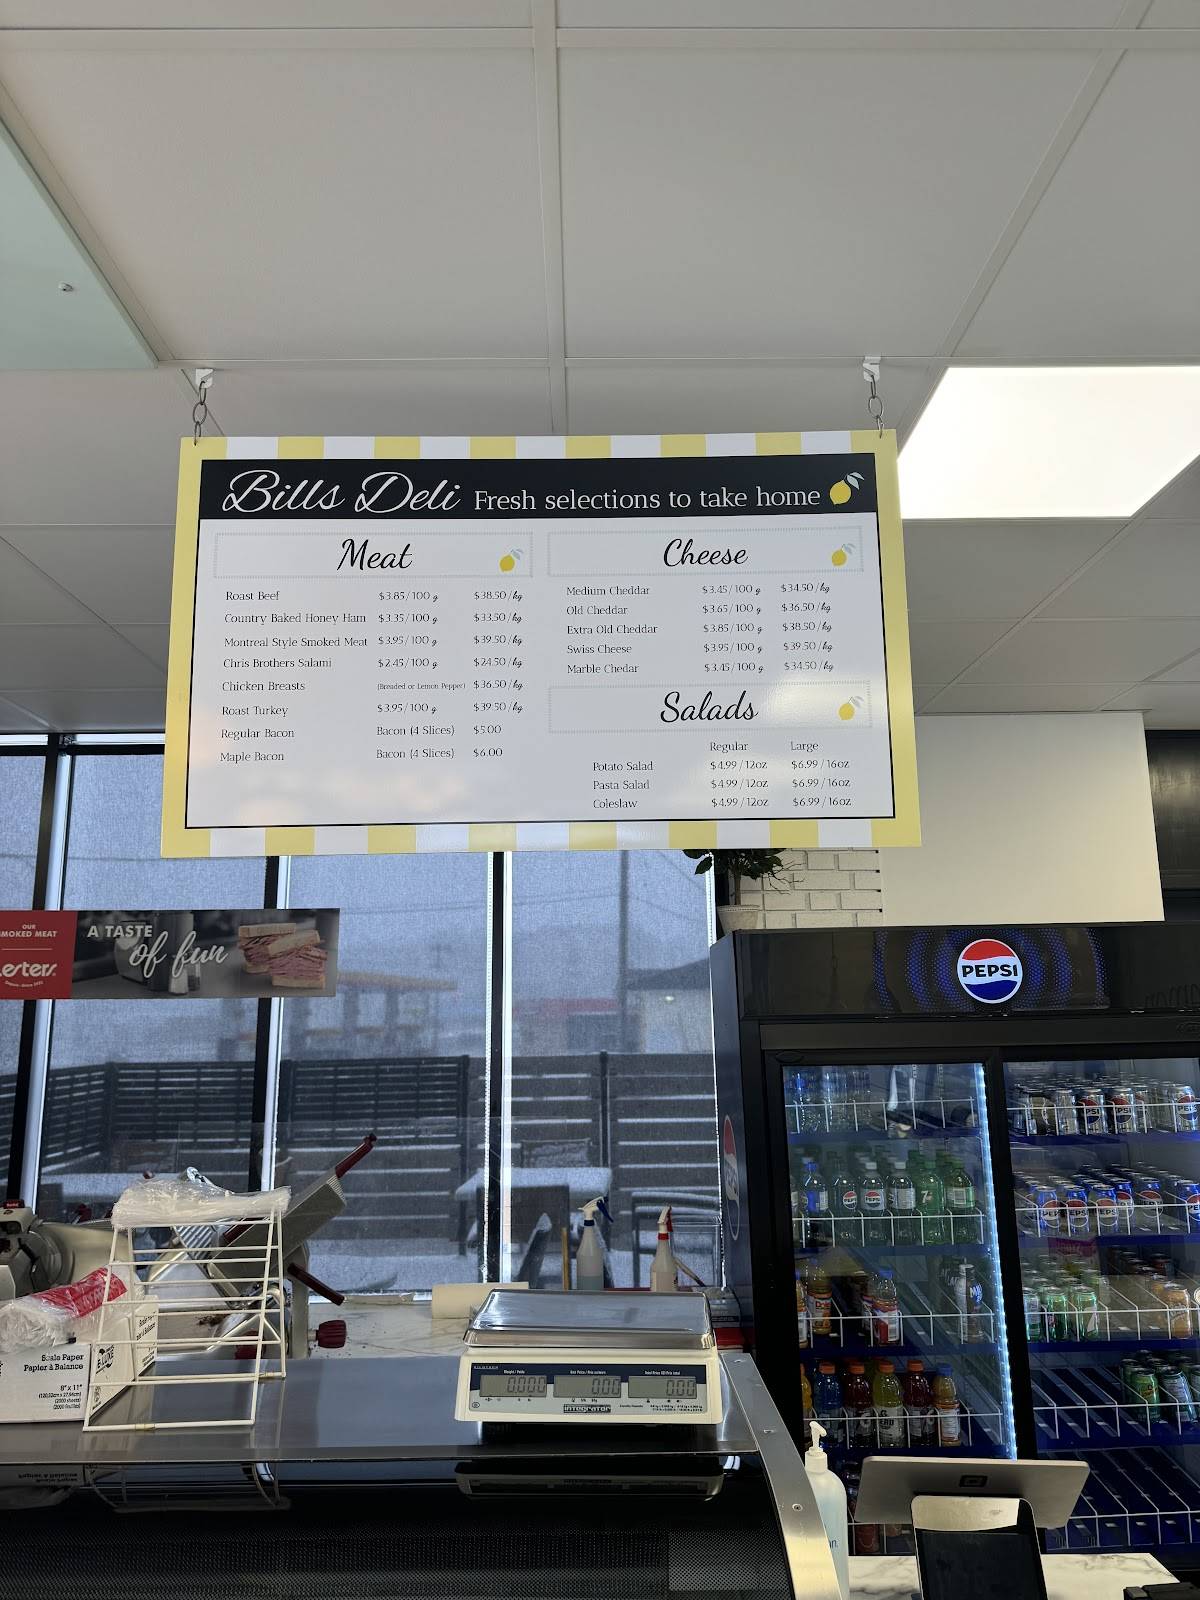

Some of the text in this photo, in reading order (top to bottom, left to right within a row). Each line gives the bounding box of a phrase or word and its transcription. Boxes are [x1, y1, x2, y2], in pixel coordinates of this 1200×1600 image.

[222, 470, 820, 513] Bills Deli Fresh selections to take home
[337, 538, 412, 570] Meat
[663, 538, 748, 567] Cheese
[226, 592, 253, 600] Roast
[258, 591, 280, 600] Beef
[379, 591, 430, 601] $3.85/100
[567, 587, 605, 596] Medium
[610, 586, 650, 595] Cheddar
[702, 585, 752, 594] $3.45/100
[567, 606, 583, 615] Old
[587, 606, 628, 615] Cheddar
[703, 604, 753, 613] $3.65/100
[224, 614, 266, 625] Country
[271, 613, 301, 623] Baked
[306, 614, 339, 625] Honey
[342, 613, 366, 623] Ham
[378, 613, 429, 623] $3.35/100
[567, 625, 592, 634] Extra
[596, 625, 613, 634] Old
[617, 625, 658, 634] Cheddar
[704, 623, 754, 633] $3.85/100
[224, 637, 268, 647] Montreal
[272, 638, 297, 649] Style
[301, 637, 340, 647] Smoked
[344, 638, 367, 647] Meat
[378, 636, 429, 645] $3.95/100
[432, 639, 437, 647] g
[567, 645, 594, 654] Swiss
[597, 644, 632, 653] Cheese
[704, 643, 754, 652] $3.95/100
[223, 659, 249, 668] Chris
[253, 658, 294, 668] Brothers
[298, 658, 332, 668] Salami
[378, 658, 429, 668] $2.45/100
[567, 664, 600, 674] Marble
[604, 664, 639, 673] Chedar
[705, 662, 755, 672] $3.45/100
[222, 682, 263, 691] Chicken
[268, 681, 305, 691] Breasts
[377, 683, 405, 691] (Breaded
[441, 682, 465, 690] Pepper)
[222, 707, 249, 715] Roast
[253, 706, 288, 717] Turkey
[378, 703, 428, 713] $3.95/100
[660, 691, 758, 722] Salads
[221, 725, 501, 740] Regular Bacon Bacon (4 Slices) $5.00
[710, 741, 818, 752] Regular Large
[220, 748, 502, 763] Maple Bacon Bacon (4 Slices) $6.00
[593, 762, 623, 771] Potato
[627, 761, 653, 771] Salad
[593, 781, 619, 790] Pasta
[623, 780, 649, 789] Salad
[593, 799, 638, 808] Coleslaw
[87, 925, 152, 937] A TASTE
[129, 930, 228, 978] of fun
[0, 962, 57, 977] esters
[962, 963, 1018, 977] PEPSI
